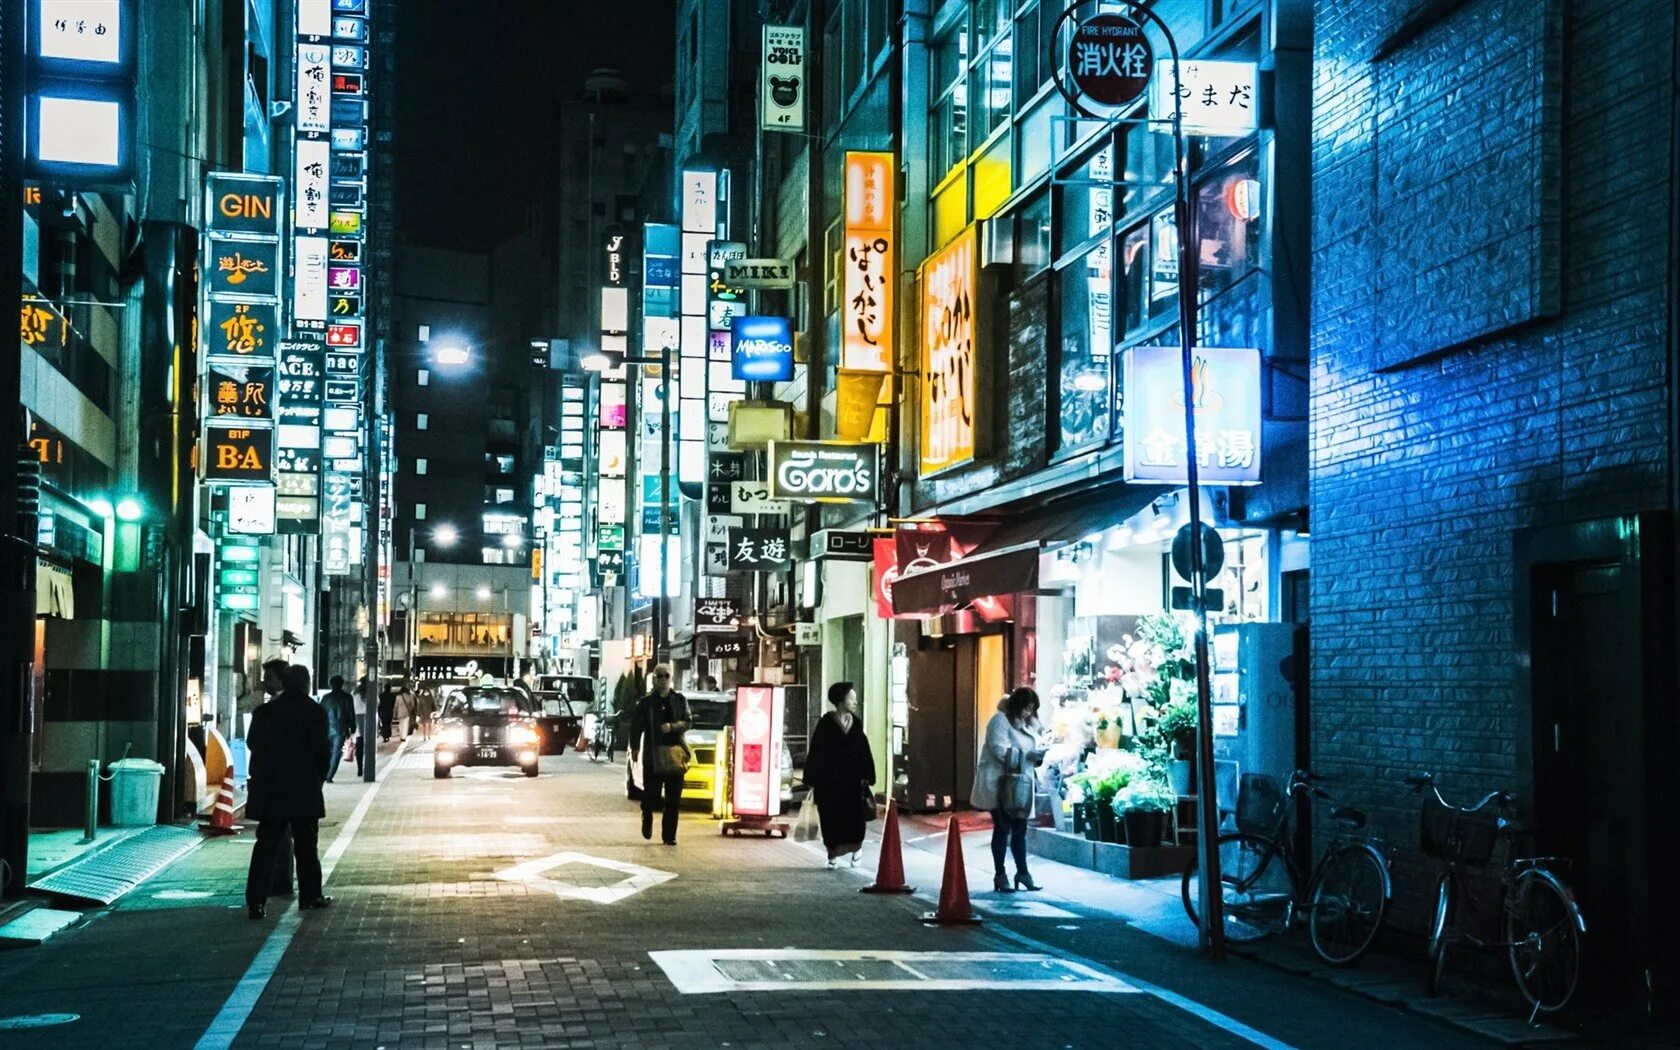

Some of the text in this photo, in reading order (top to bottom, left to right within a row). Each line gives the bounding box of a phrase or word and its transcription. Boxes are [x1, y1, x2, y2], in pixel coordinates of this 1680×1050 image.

[1081, 25, 1139, 37] FIRE HYDRANT
[772, 46, 798, 55] VOICE
[1075, 41, 1148, 78] 消火栓
[778, 115, 791, 123] 4F
[219, 193, 271, 219] GIN
[729, 265, 789, 279] MIKI
[850, 237, 889, 346] ぱいかじ
[327, 357, 357, 369] nao
[734, 536, 786, 563] 友遊
